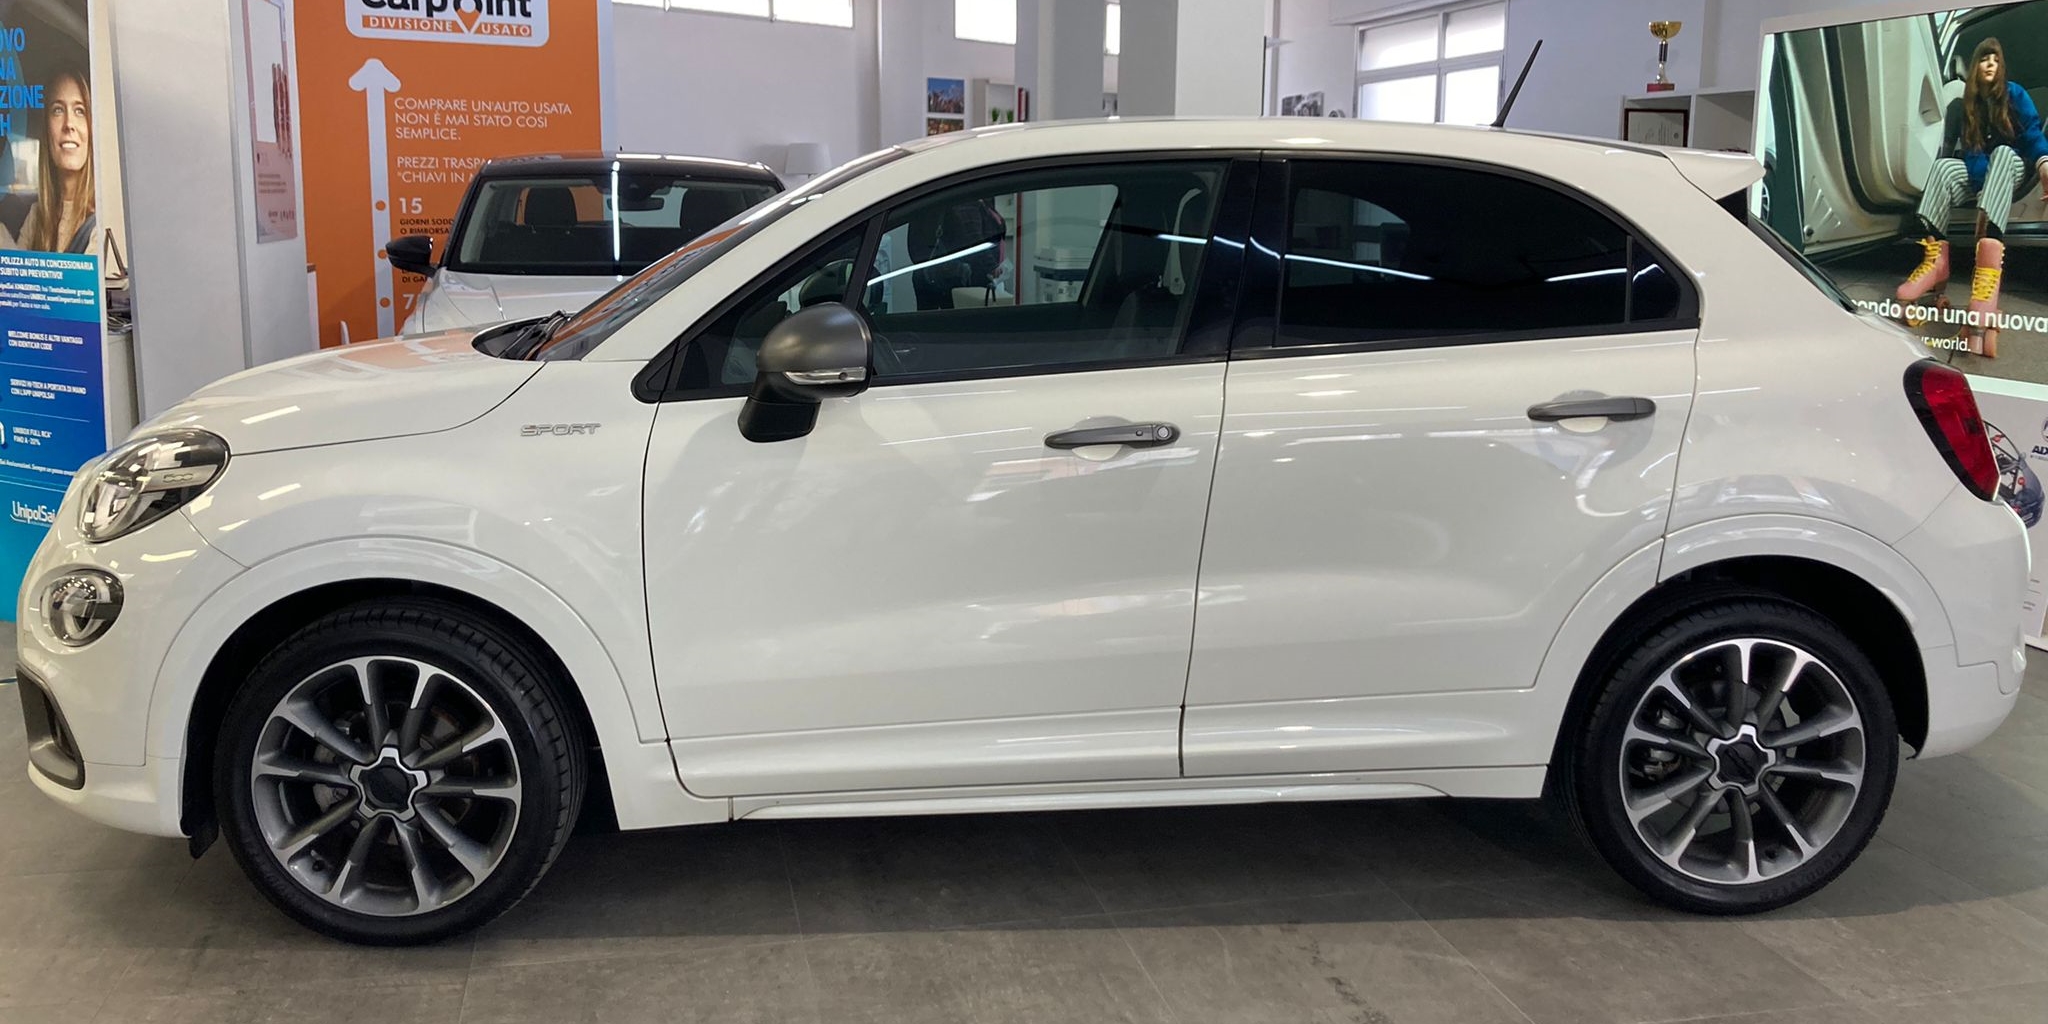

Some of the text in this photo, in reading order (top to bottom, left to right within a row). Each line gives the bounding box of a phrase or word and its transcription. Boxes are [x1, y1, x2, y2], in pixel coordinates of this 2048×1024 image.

[370, 16, 530, 36] DIVISIONE USATO
[394, 98, 572, 115] COMPRARE UN'AUTO USATA
[396, 113, 430, 124] NON
[434, 111, 441, 125] È
[446, 114, 469, 126] MAI
[474, 115, 512, 127] STATO
[396, 128, 461, 140] SEMPLICE.
[397, 156, 438, 168] PREZZI
[451, 172, 465, 183] IN
[399, 197, 422, 214] 15
[24, 258, 39, 266] AUTO
[1851, 298, 2048, 332] ondo con una nuova
[1931, 337, 1971, 352] world.
[520, 423, 601, 436] SPORT
[162, 473, 193, 483] 500
[12, 500, 55, 524] UnipolSai
